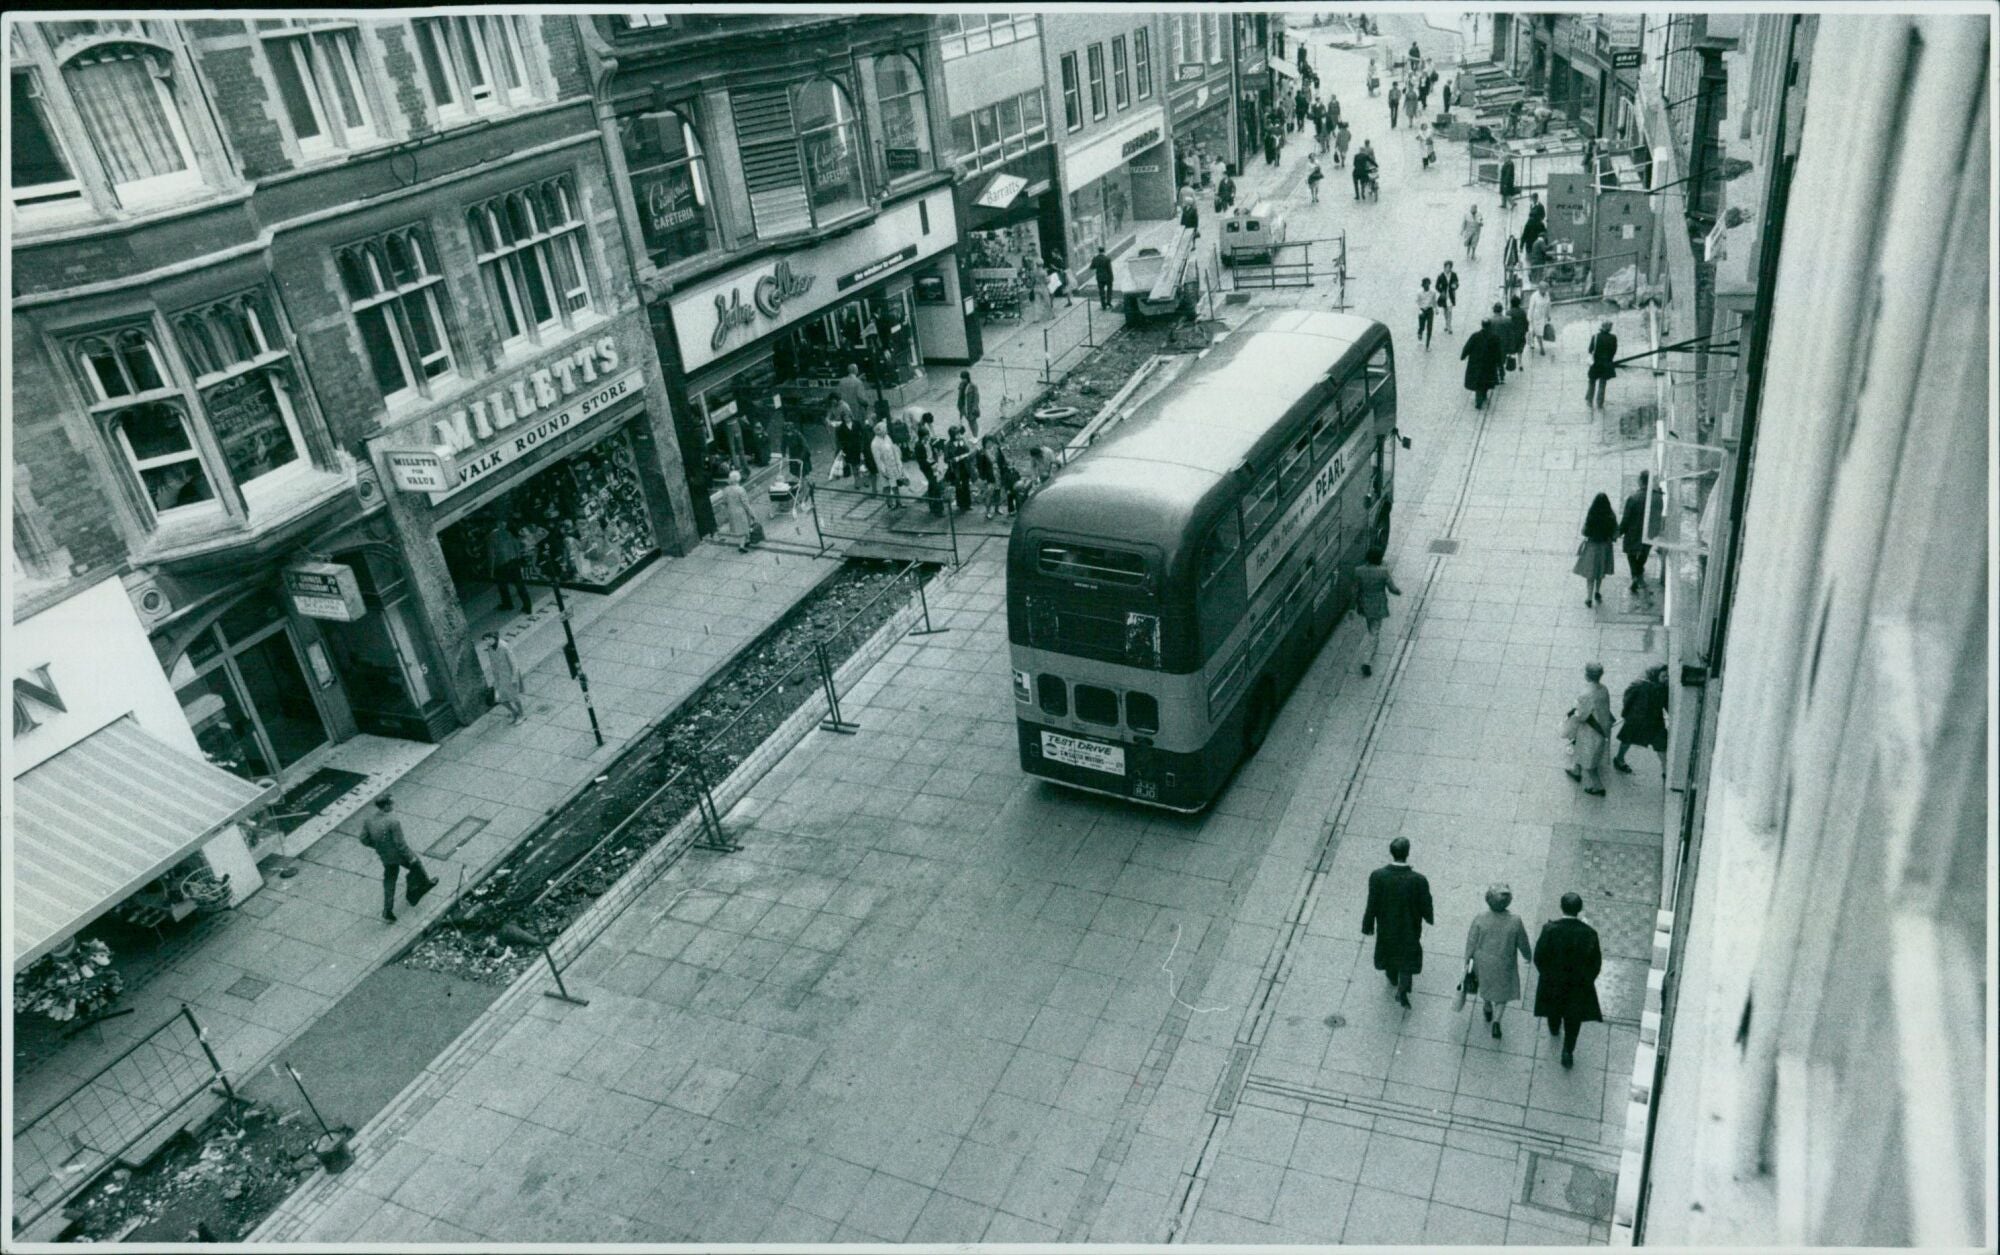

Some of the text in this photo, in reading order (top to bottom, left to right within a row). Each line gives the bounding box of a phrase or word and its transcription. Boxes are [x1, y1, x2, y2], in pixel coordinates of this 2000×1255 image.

[817, 166, 851, 187] CAFETERIA
[986, 182, 1020, 204] Barratts
[653, 207, 695, 231] CAFETERIA
[711, 260, 817, 351] John Collier
[435, 336, 619, 455] MILLETTS
[515, 413, 571, 453] ROUND
[582, 381, 628, 414] STORE
[393, 457, 438, 467] MILLETTS
[406, 476, 436, 486] VALUE
[1315, 454, 1345, 504] PEARL
[1048, 735, 1075, 747] TEST
[1077, 741, 1113, 756] DRIVE
